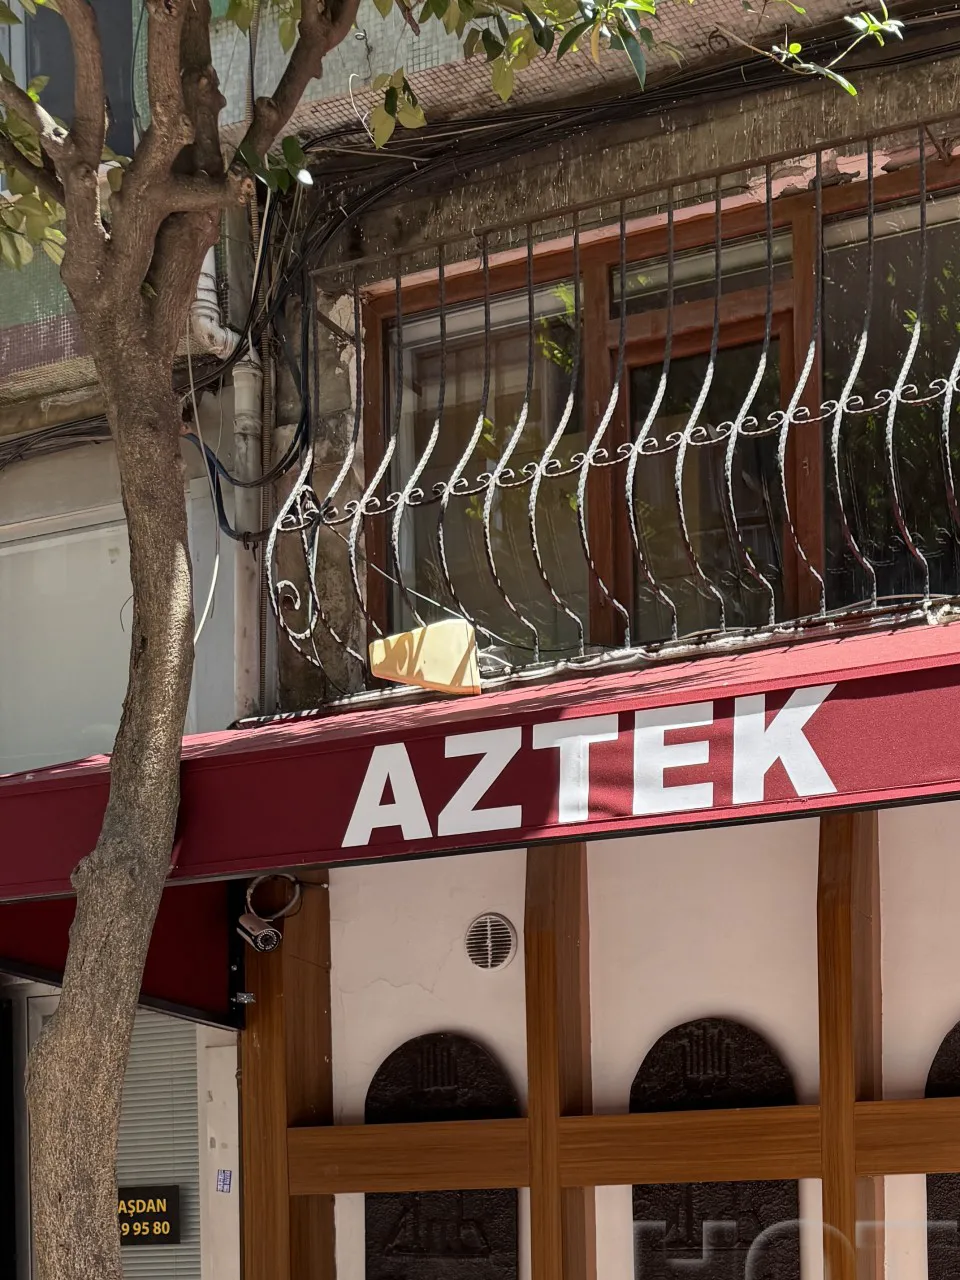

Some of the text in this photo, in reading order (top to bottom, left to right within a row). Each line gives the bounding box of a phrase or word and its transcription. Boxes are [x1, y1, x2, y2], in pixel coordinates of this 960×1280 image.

[341, 683, 838, 848] AZTEK
[118, 1198, 167, 1217] AŞDAN
[132, 1221, 150, 1236] 95
[152, 1221, 170, 1235] 80
